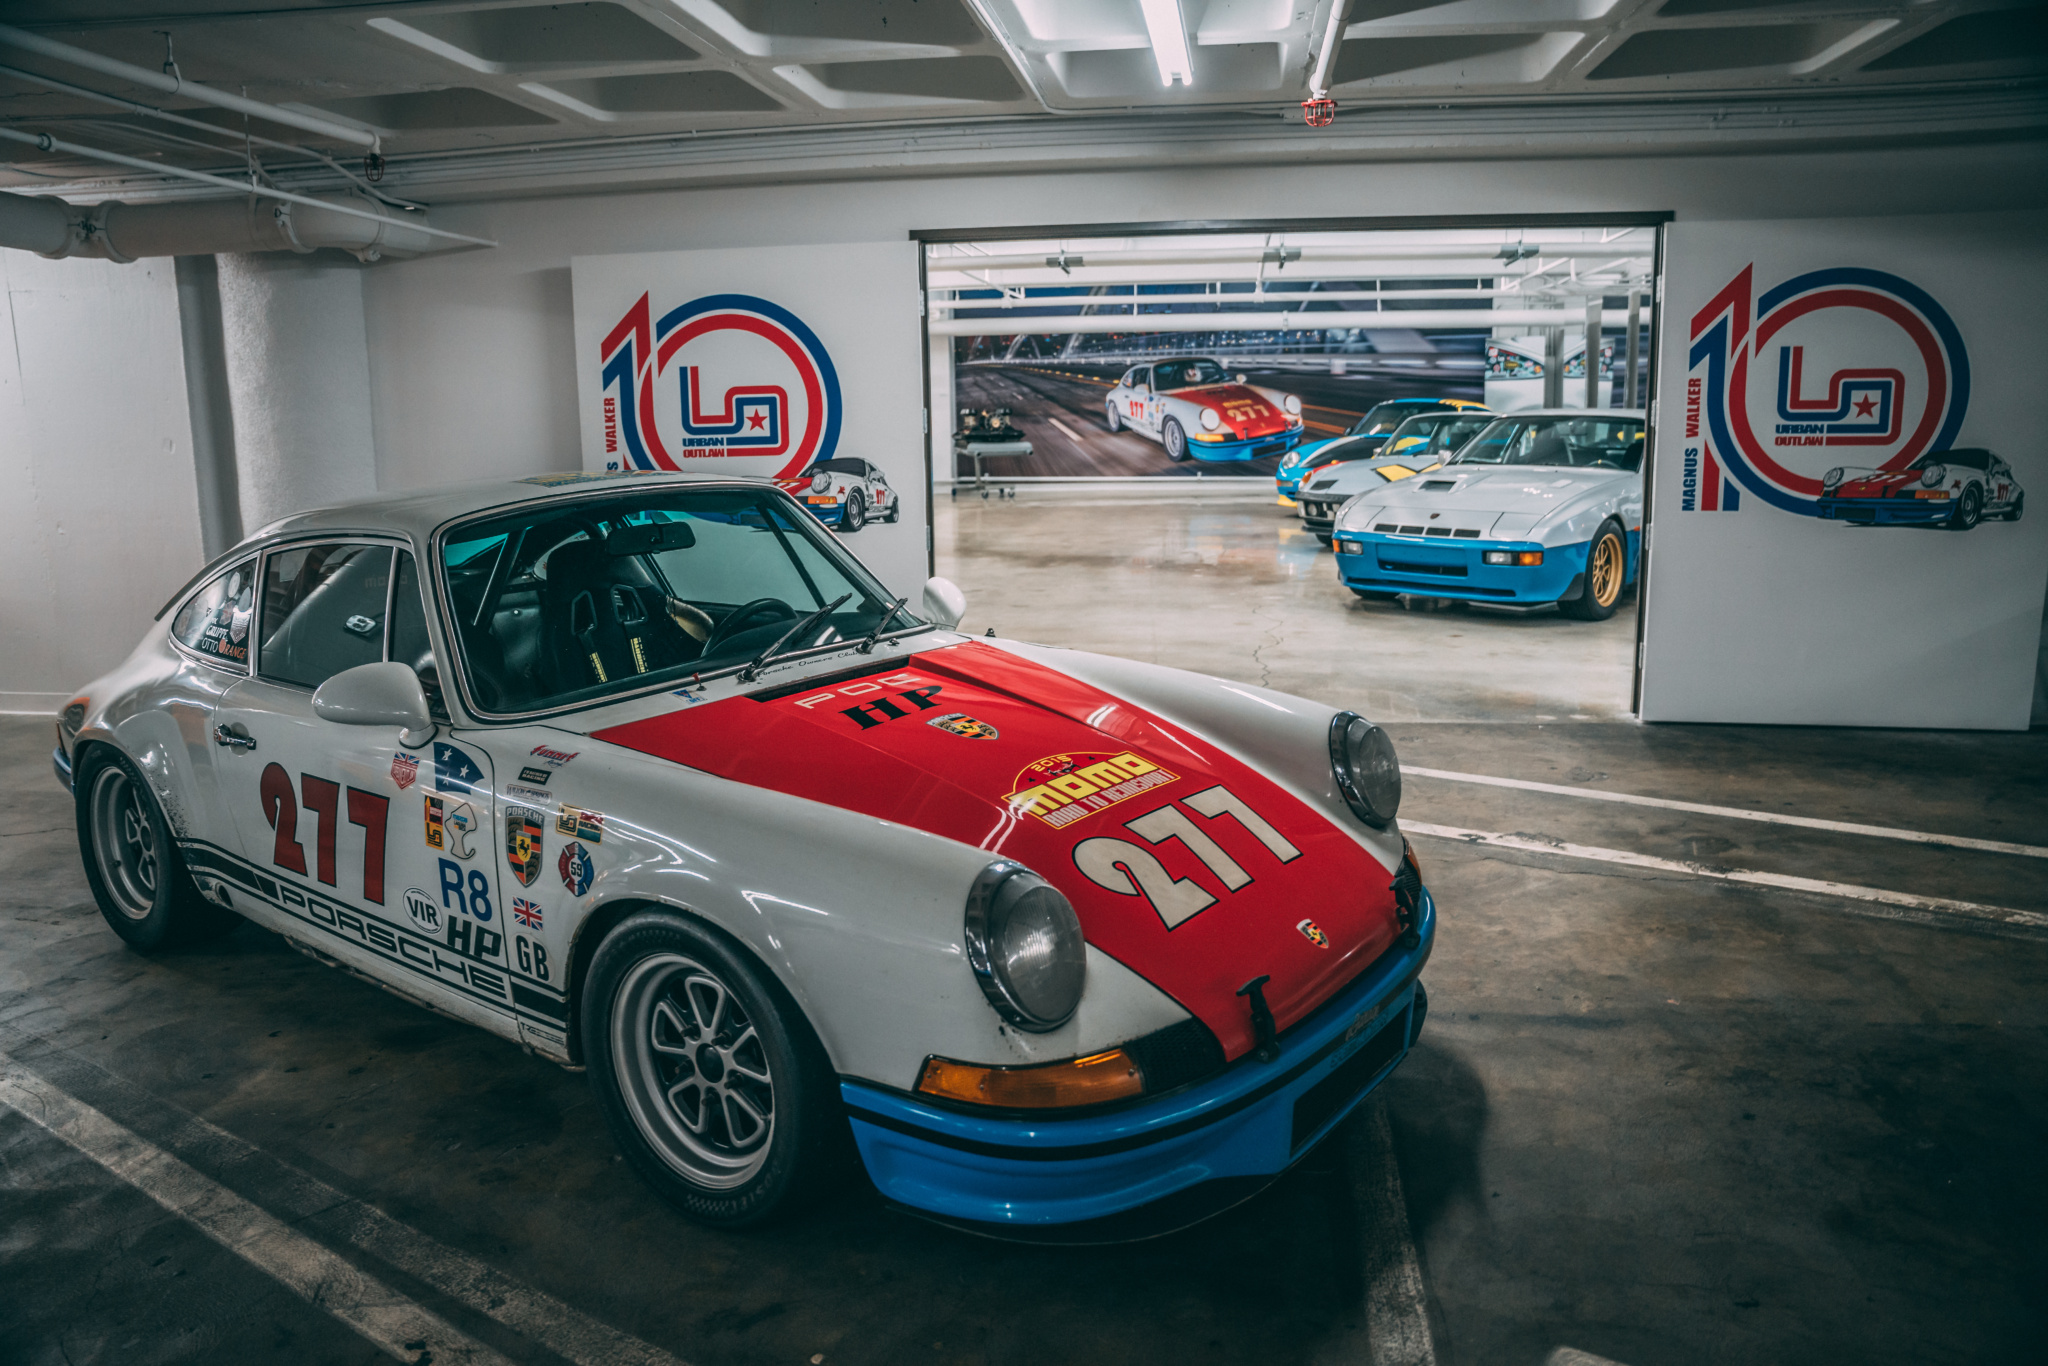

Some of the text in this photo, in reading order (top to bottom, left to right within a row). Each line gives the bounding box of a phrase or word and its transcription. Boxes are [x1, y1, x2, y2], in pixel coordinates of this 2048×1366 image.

[604, 398, 617, 453] WALKER
[1129, 400, 1144, 419] 277
[1227, 404, 1270, 422] 277
[683, 438, 724, 447] URBAN
[1682, 378, 1701, 511] MAGNUS WALKER
[1775, 436, 1824, 446] OUTLAW
[1776, 424, 1824, 434] URBAN
[683, 448, 725, 458] OUTLAW
[794, 673, 922, 709] POC
[838, 686, 943, 730] HP
[506, 807, 543, 825] PORSCHE
[1042, 804, 1089, 827] ROAD
[1080, 795, 1109, 809] TO
[260, 762, 390, 906] 277
[570, 861, 582, 877] 59
[1071, 784, 1304, 933] 277
[438, 857, 492, 922] R8
[406, 896, 440, 927] VIR
[282, 885, 507, 999] PORSCHE
[447, 915, 502, 959] HP
[515, 935, 550, 982] GB
